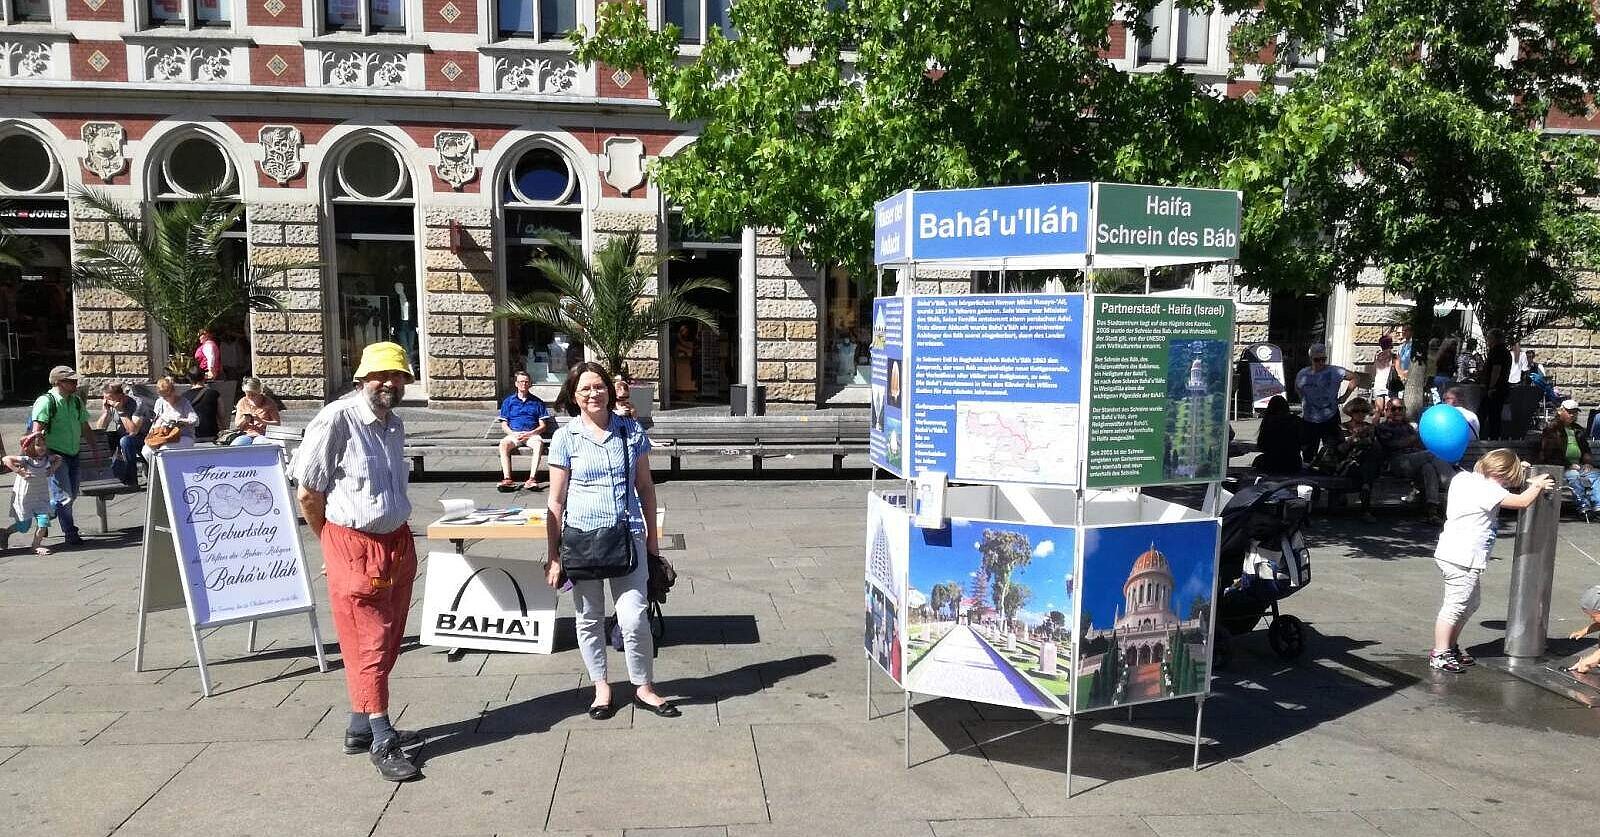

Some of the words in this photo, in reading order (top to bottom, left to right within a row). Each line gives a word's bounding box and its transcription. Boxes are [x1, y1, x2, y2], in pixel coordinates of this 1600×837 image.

[29, 209, 68, 218] JONES
[1146, 195, 1192, 216] Haifa
[920, 204, 1078, 239] Bahá'u'lláh
[1097, 224, 1162, 244] Schrein
[1168, 227, 1198, 246] des
[1203, 227, 1236, 248] Báb
[1102, 302, 1160, 314] Partnerstadt
[1168, 304, 1192, 315] Haifa
[1194, 304, 1224, 317] (Israel)
[232, 470, 258, 478] zum
[199, 521, 278, 552] Geburtstag
[436, 613, 539, 636] BAHA'I
